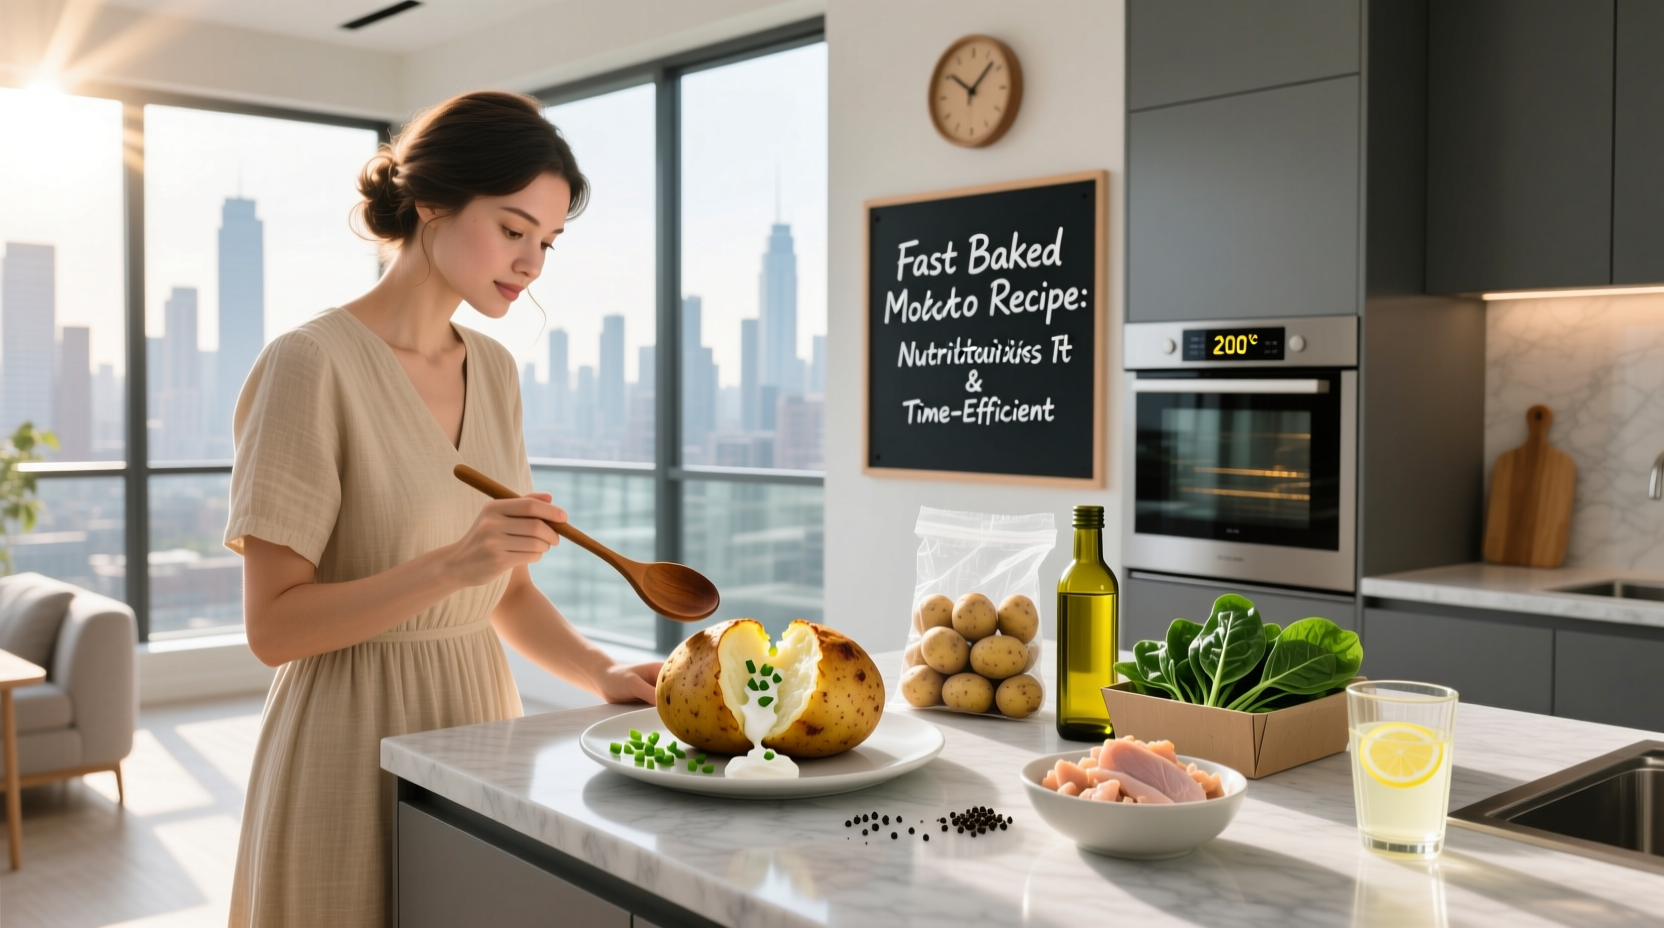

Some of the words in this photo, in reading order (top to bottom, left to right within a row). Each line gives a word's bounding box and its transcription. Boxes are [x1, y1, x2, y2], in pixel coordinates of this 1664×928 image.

[897, 239, 958, 282] Fast
[967, 226, 1064, 275] Baked
[989, 277, 1088, 326] Recipe:
[964, 368, 983, 393] &
[902, 395, 1055, 426] Time-Efficient
